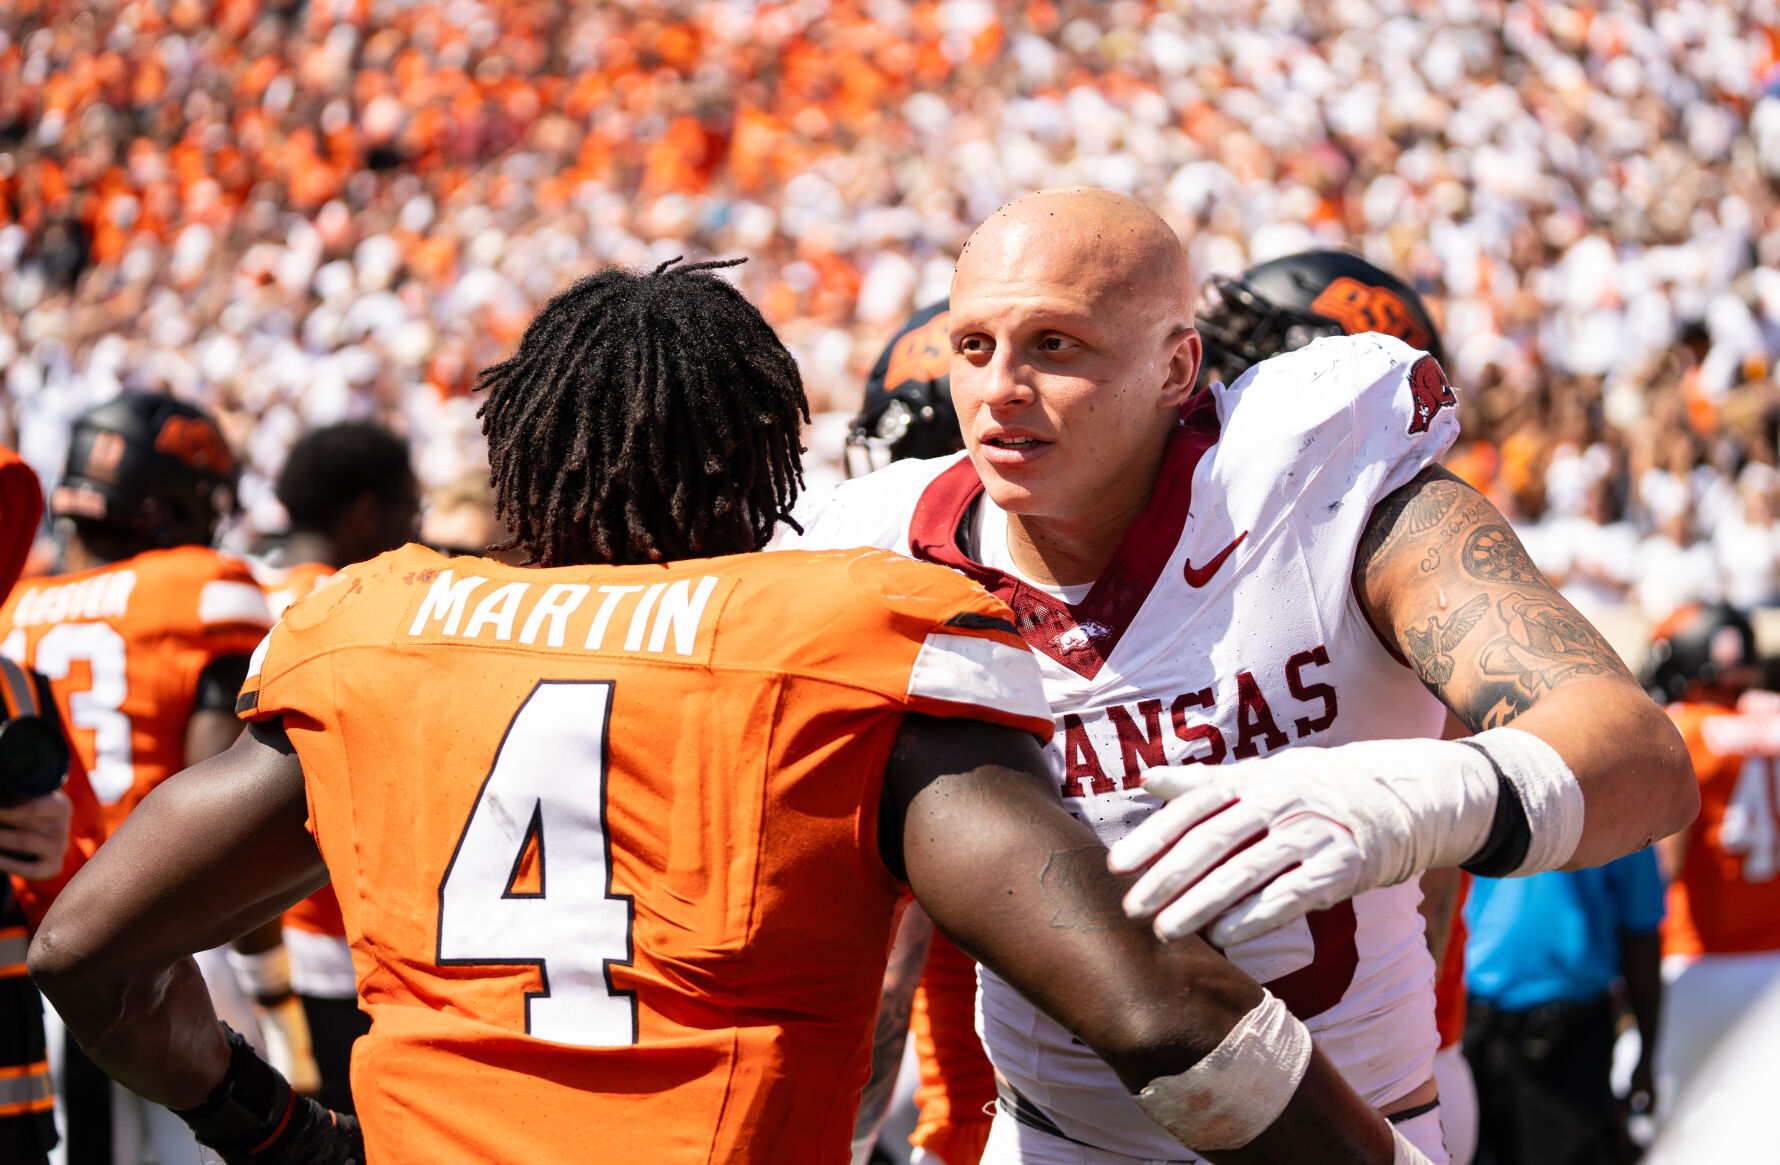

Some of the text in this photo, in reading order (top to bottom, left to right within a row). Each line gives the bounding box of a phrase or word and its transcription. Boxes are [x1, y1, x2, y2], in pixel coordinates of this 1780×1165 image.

[409, 569, 719, 656] MARTIN
[0, 622, 135, 806] 3
[436, 679, 638, 1046] 4
[1718, 755, 1780, 883] 4
